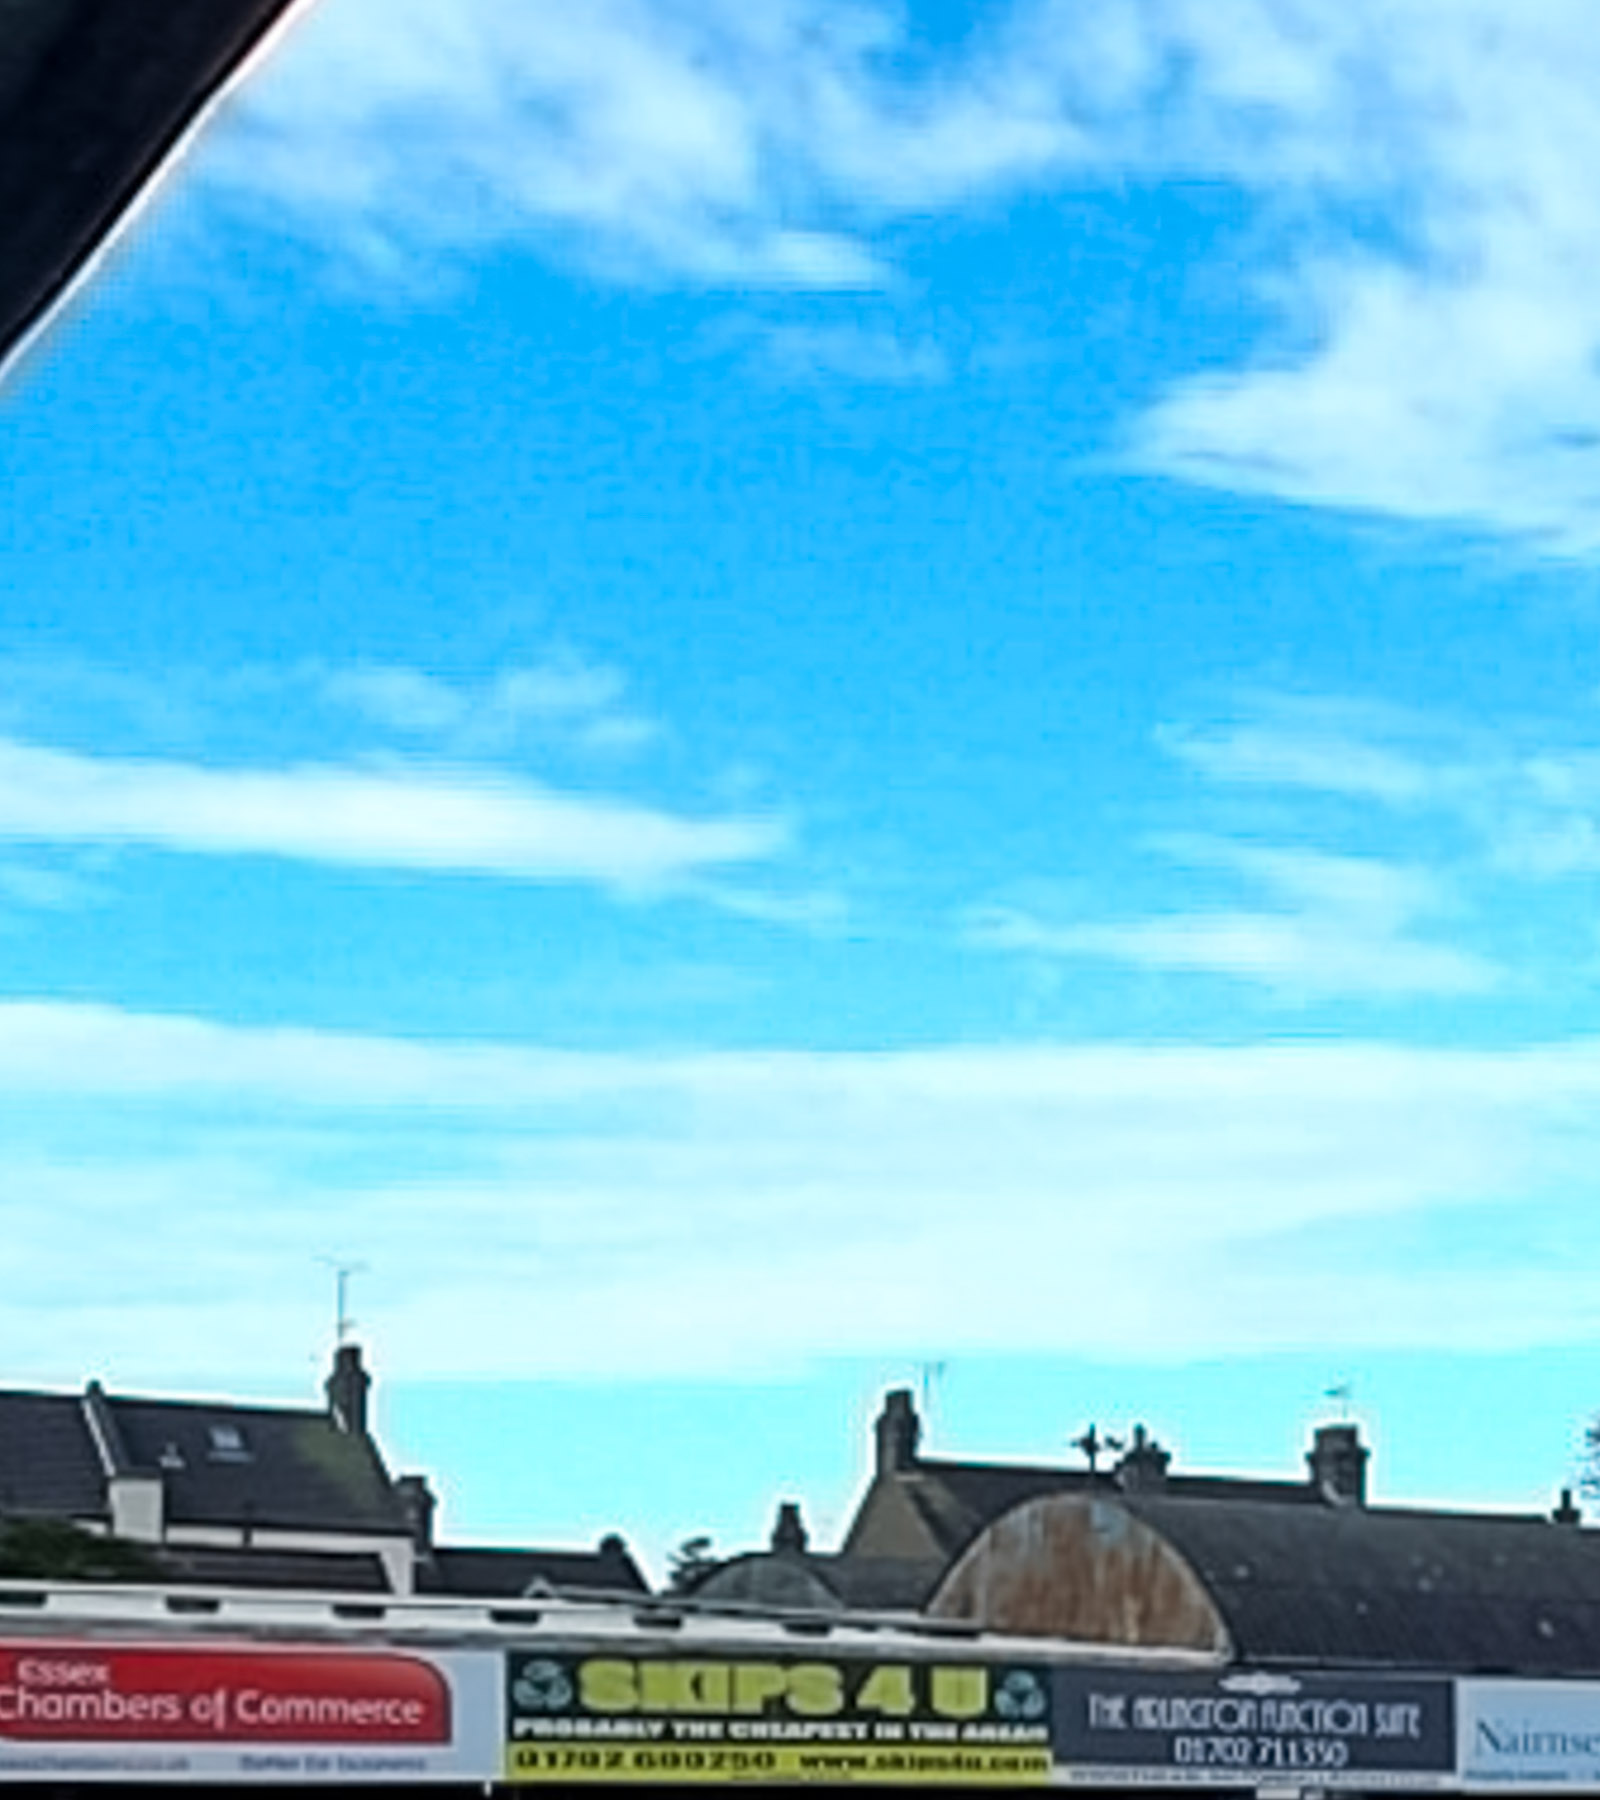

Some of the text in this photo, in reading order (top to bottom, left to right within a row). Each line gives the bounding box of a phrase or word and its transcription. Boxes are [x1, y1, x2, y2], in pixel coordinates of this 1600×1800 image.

[18, 1659, 108, 1684] Essex
[578, 1660, 988, 1716] SKIPS 4 U
[190, 1693, 226, 1730] of
[234, 1692, 424, 1726] Commerce
